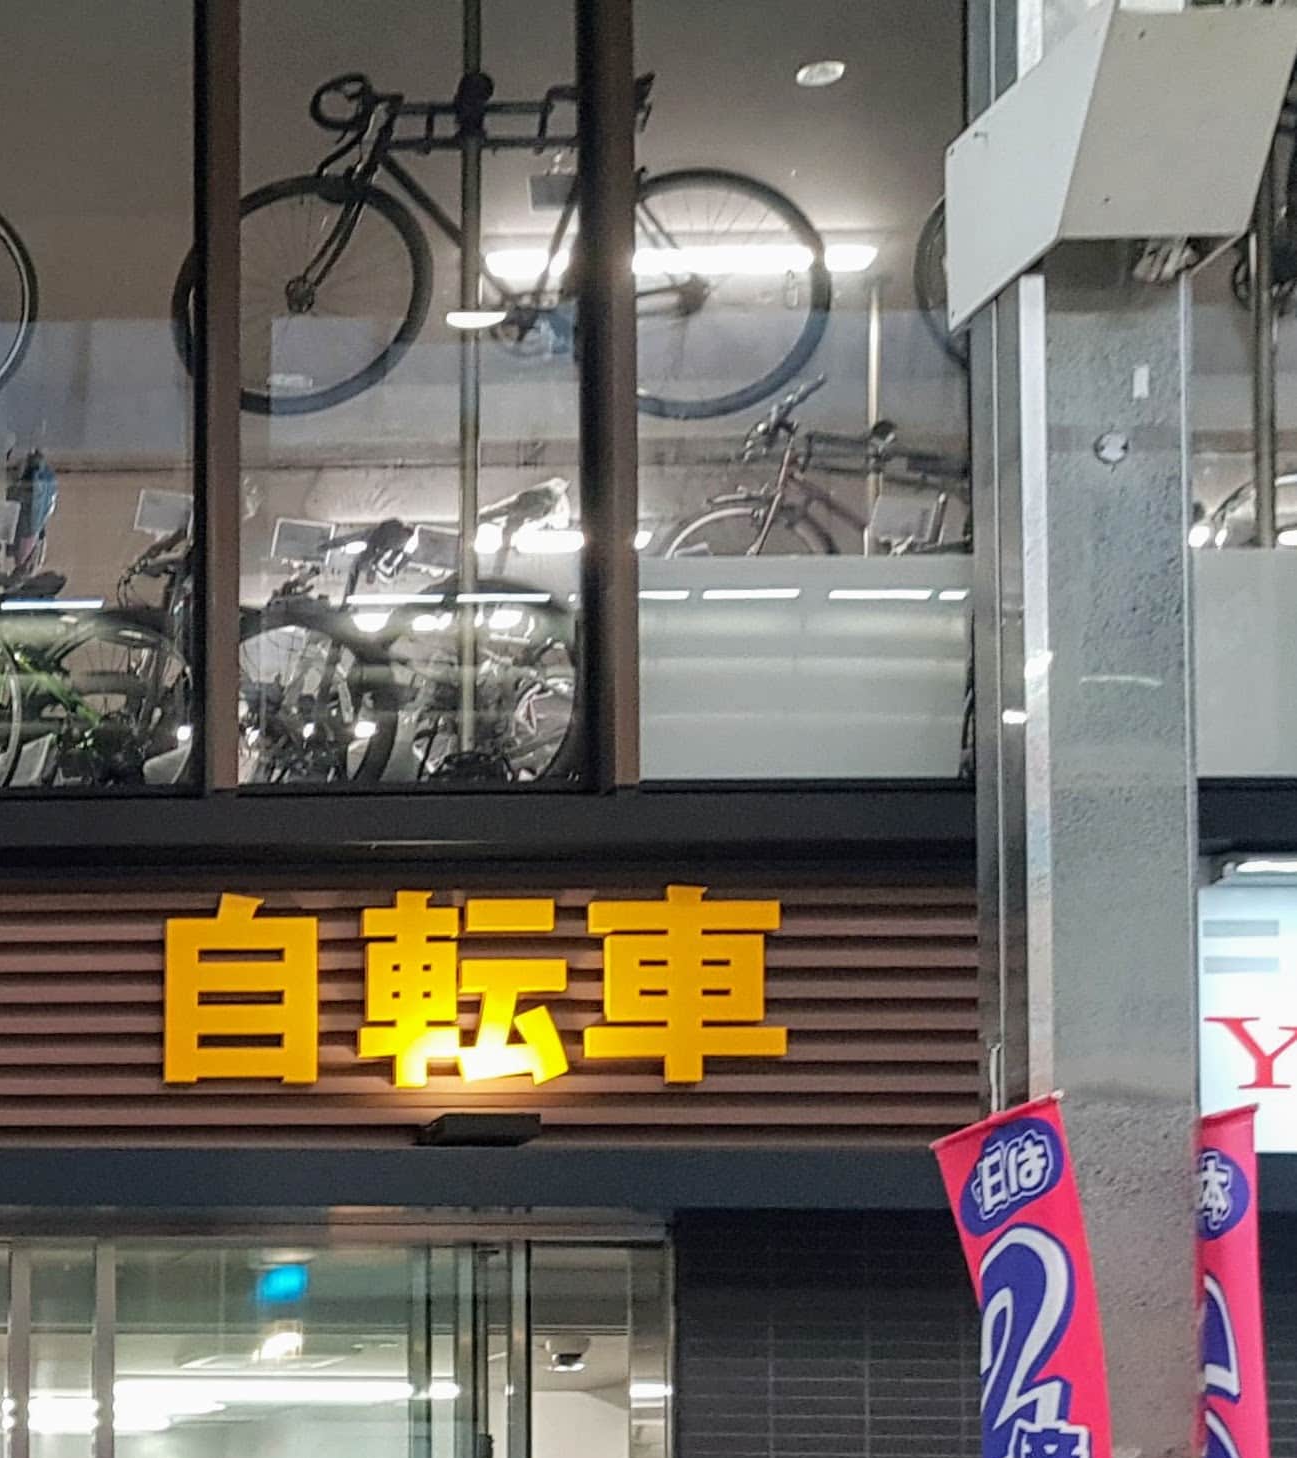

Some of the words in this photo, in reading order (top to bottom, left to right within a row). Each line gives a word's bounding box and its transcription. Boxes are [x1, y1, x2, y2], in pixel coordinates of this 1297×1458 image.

[163, 885, 787, 1088] 自転車
[973, 1133, 1050, 1217] 日は
